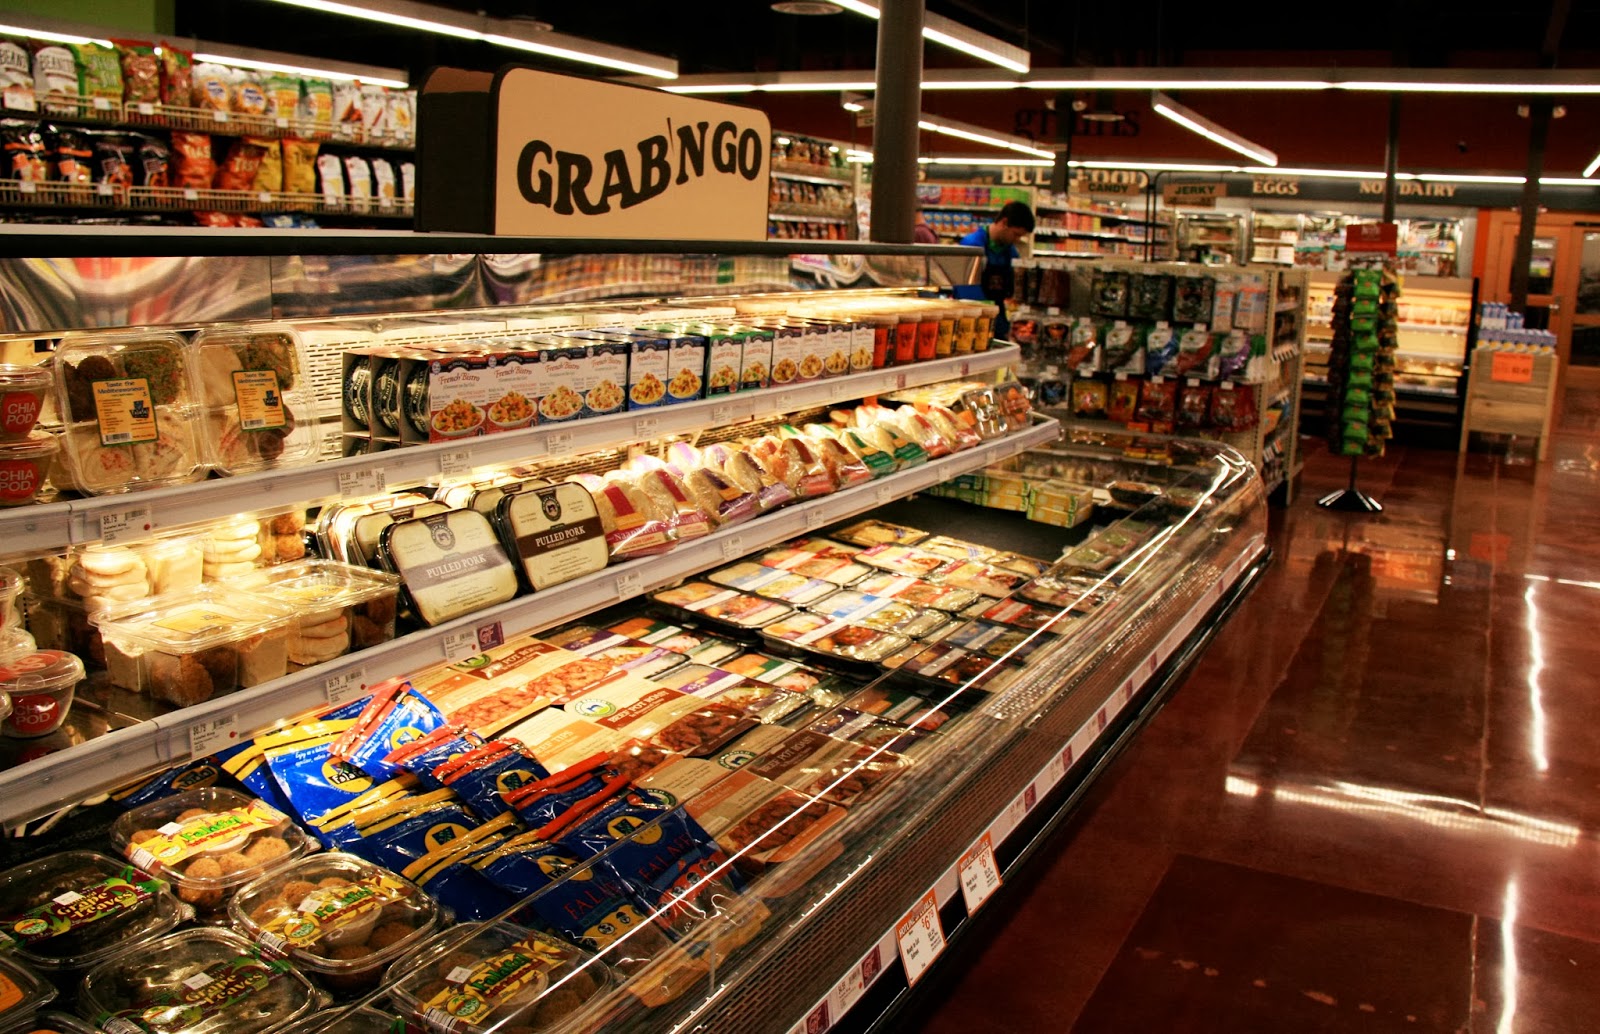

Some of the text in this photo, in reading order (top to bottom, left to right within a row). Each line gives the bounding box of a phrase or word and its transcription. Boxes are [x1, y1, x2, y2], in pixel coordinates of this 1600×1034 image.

[517, 135, 671, 216] GRAB
[712, 121, 763, 181] GO
[1002, 165, 1052, 185] BUL
[1088, 182, 1129, 192] CANDY
[1175, 185, 1216, 195] JERKY
[1252, 181, 1299, 195] EGGS
[1359, 180, 1457, 197] NO DAIRY
[438, 372, 480, 385] French Bistro
[8, 402, 36, 415] CHIA
[6, 413, 34, 426] POD
[0, 470, 34, 481] CHIA
[0, 481, 31, 492] POD
[535, 526, 586, 548] PULLED PORK
[426, 561, 462, 579] PULLED
[462, 553, 487, 568] PORK
[629, 702, 648, 713] POT
[16, 712, 51, 726] POD
[777, 748, 795, 761] POT
[790, 735, 816, 751] ROAST
[180, 815, 242, 842] Falafel
[57, 892, 109, 915] Grape
[70, 891, 134, 919] Leaves
[471, 952, 531, 991] Falafel
[186, 973, 238, 1002] Grape
[205, 972, 263, 1005] Leaves
